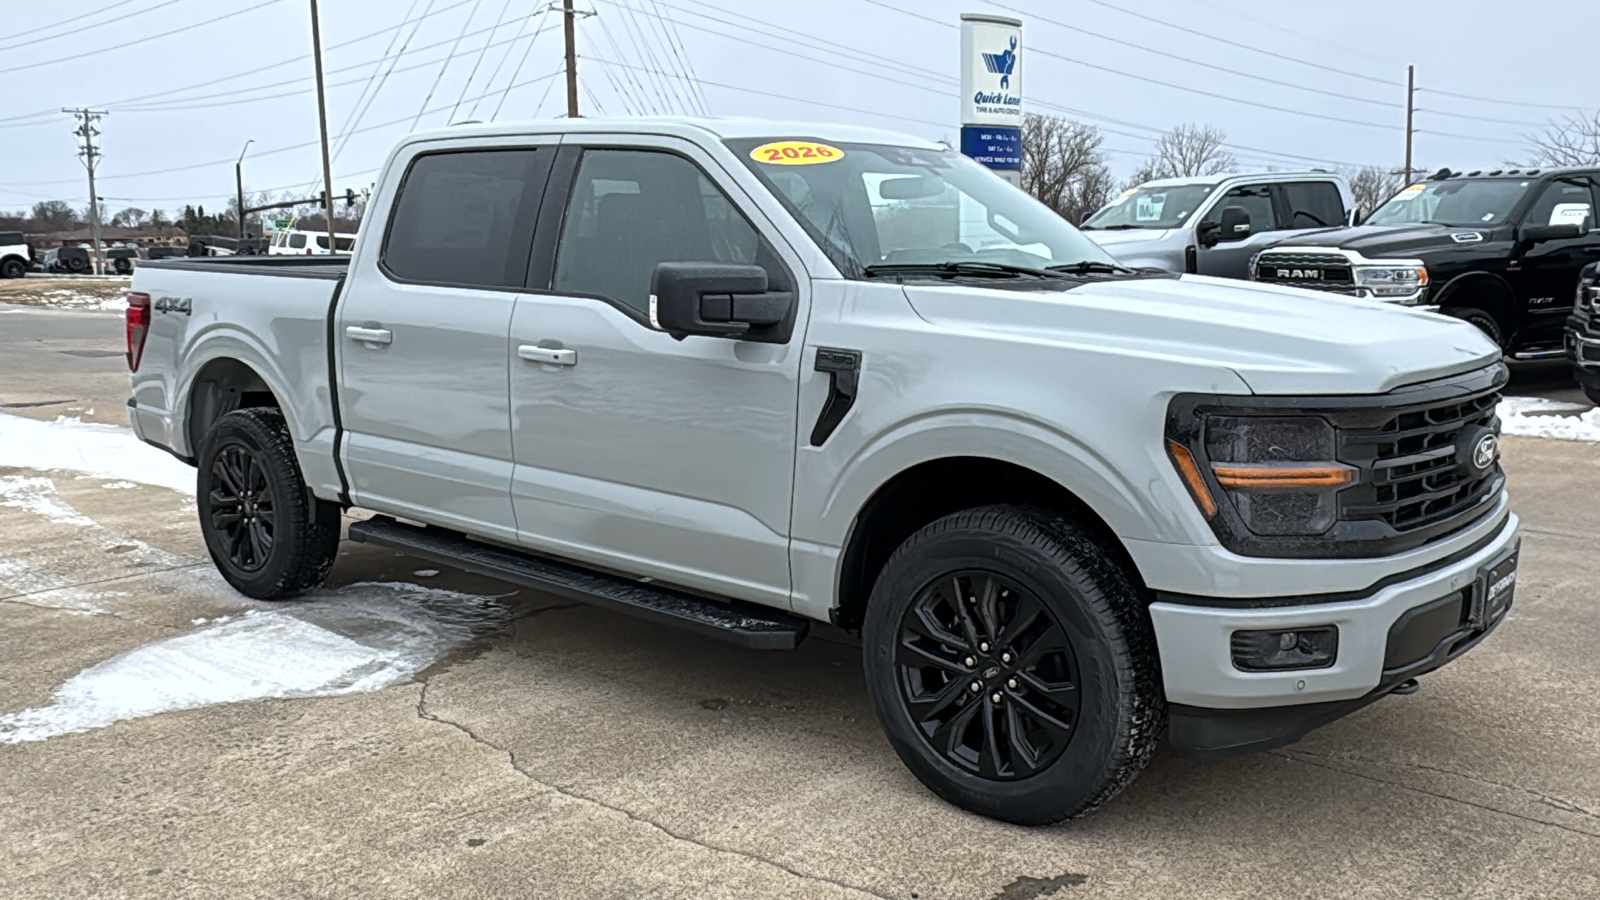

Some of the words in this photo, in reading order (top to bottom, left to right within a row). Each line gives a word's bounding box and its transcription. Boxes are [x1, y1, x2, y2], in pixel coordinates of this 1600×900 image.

[974, 91, 1002, 104] Quick
[1003, 94, 1020, 105] Lane
[764, 147, 833, 161] 2026
[1277, 269, 1318, 278] RAM
[1477, 438, 1495, 465] Ford
